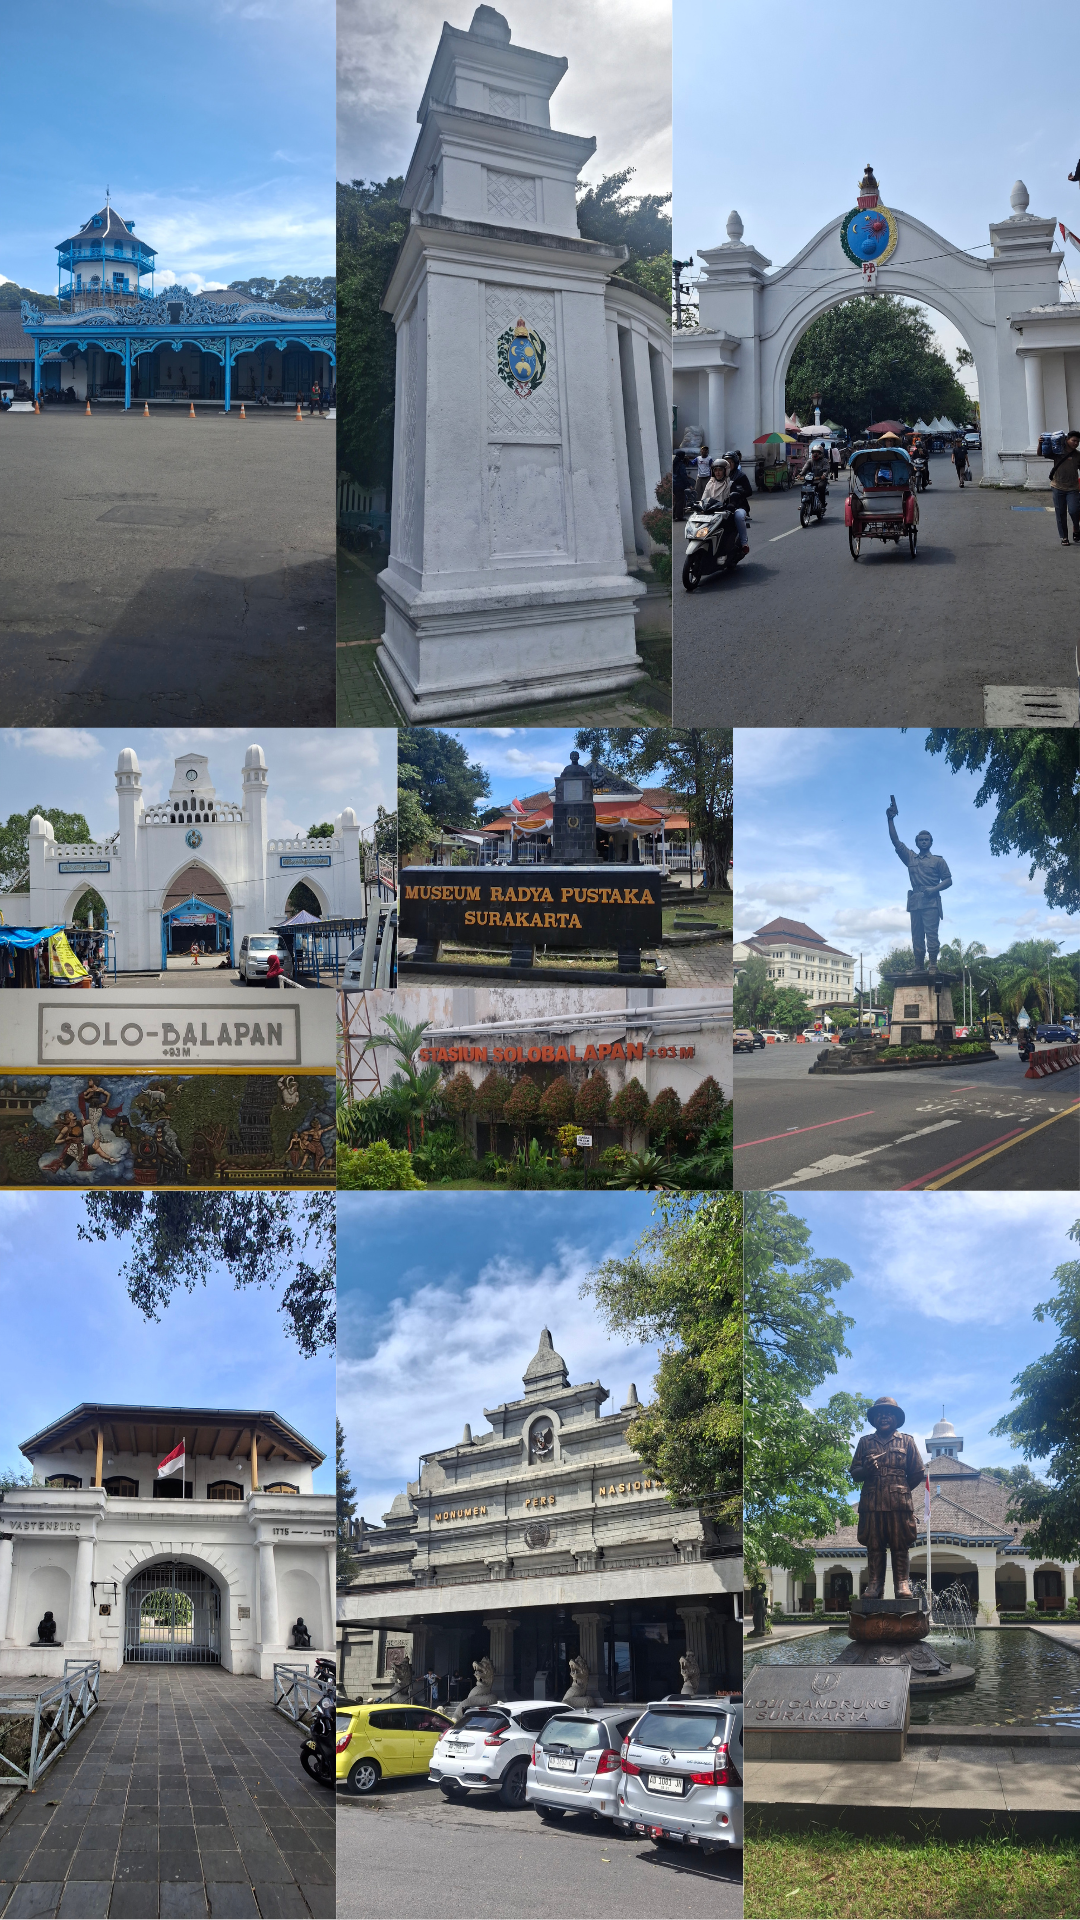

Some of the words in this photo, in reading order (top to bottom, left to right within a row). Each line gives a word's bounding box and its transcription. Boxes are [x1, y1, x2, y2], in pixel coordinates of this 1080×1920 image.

[863, 263, 876, 274] PB
[405, 886, 481, 900] MUSEUM
[490, 886, 554, 902] RADYA
[561, 888, 655, 904] PUSTAKA
[465, 911, 582, 929] SURAKARTA
[57, 1022, 282, 1046] SOLO-BALAPAN
[420, 1046, 487, 1062] STASIUN
[647, 1046, 677, 1059] +93
[680, 1047, 694, 1059] M
[435, 1506, 487, 1521] MONUMEN
[525, 1495, 556, 1507] PERS
[9, 1520, 81, 1531] VASTENBURG
[744, 1700, 784, 1709] LOJI
[788, 1700, 891, 1710] GANDRUNG
[755, 1711, 869, 1722] SURAKARTA
